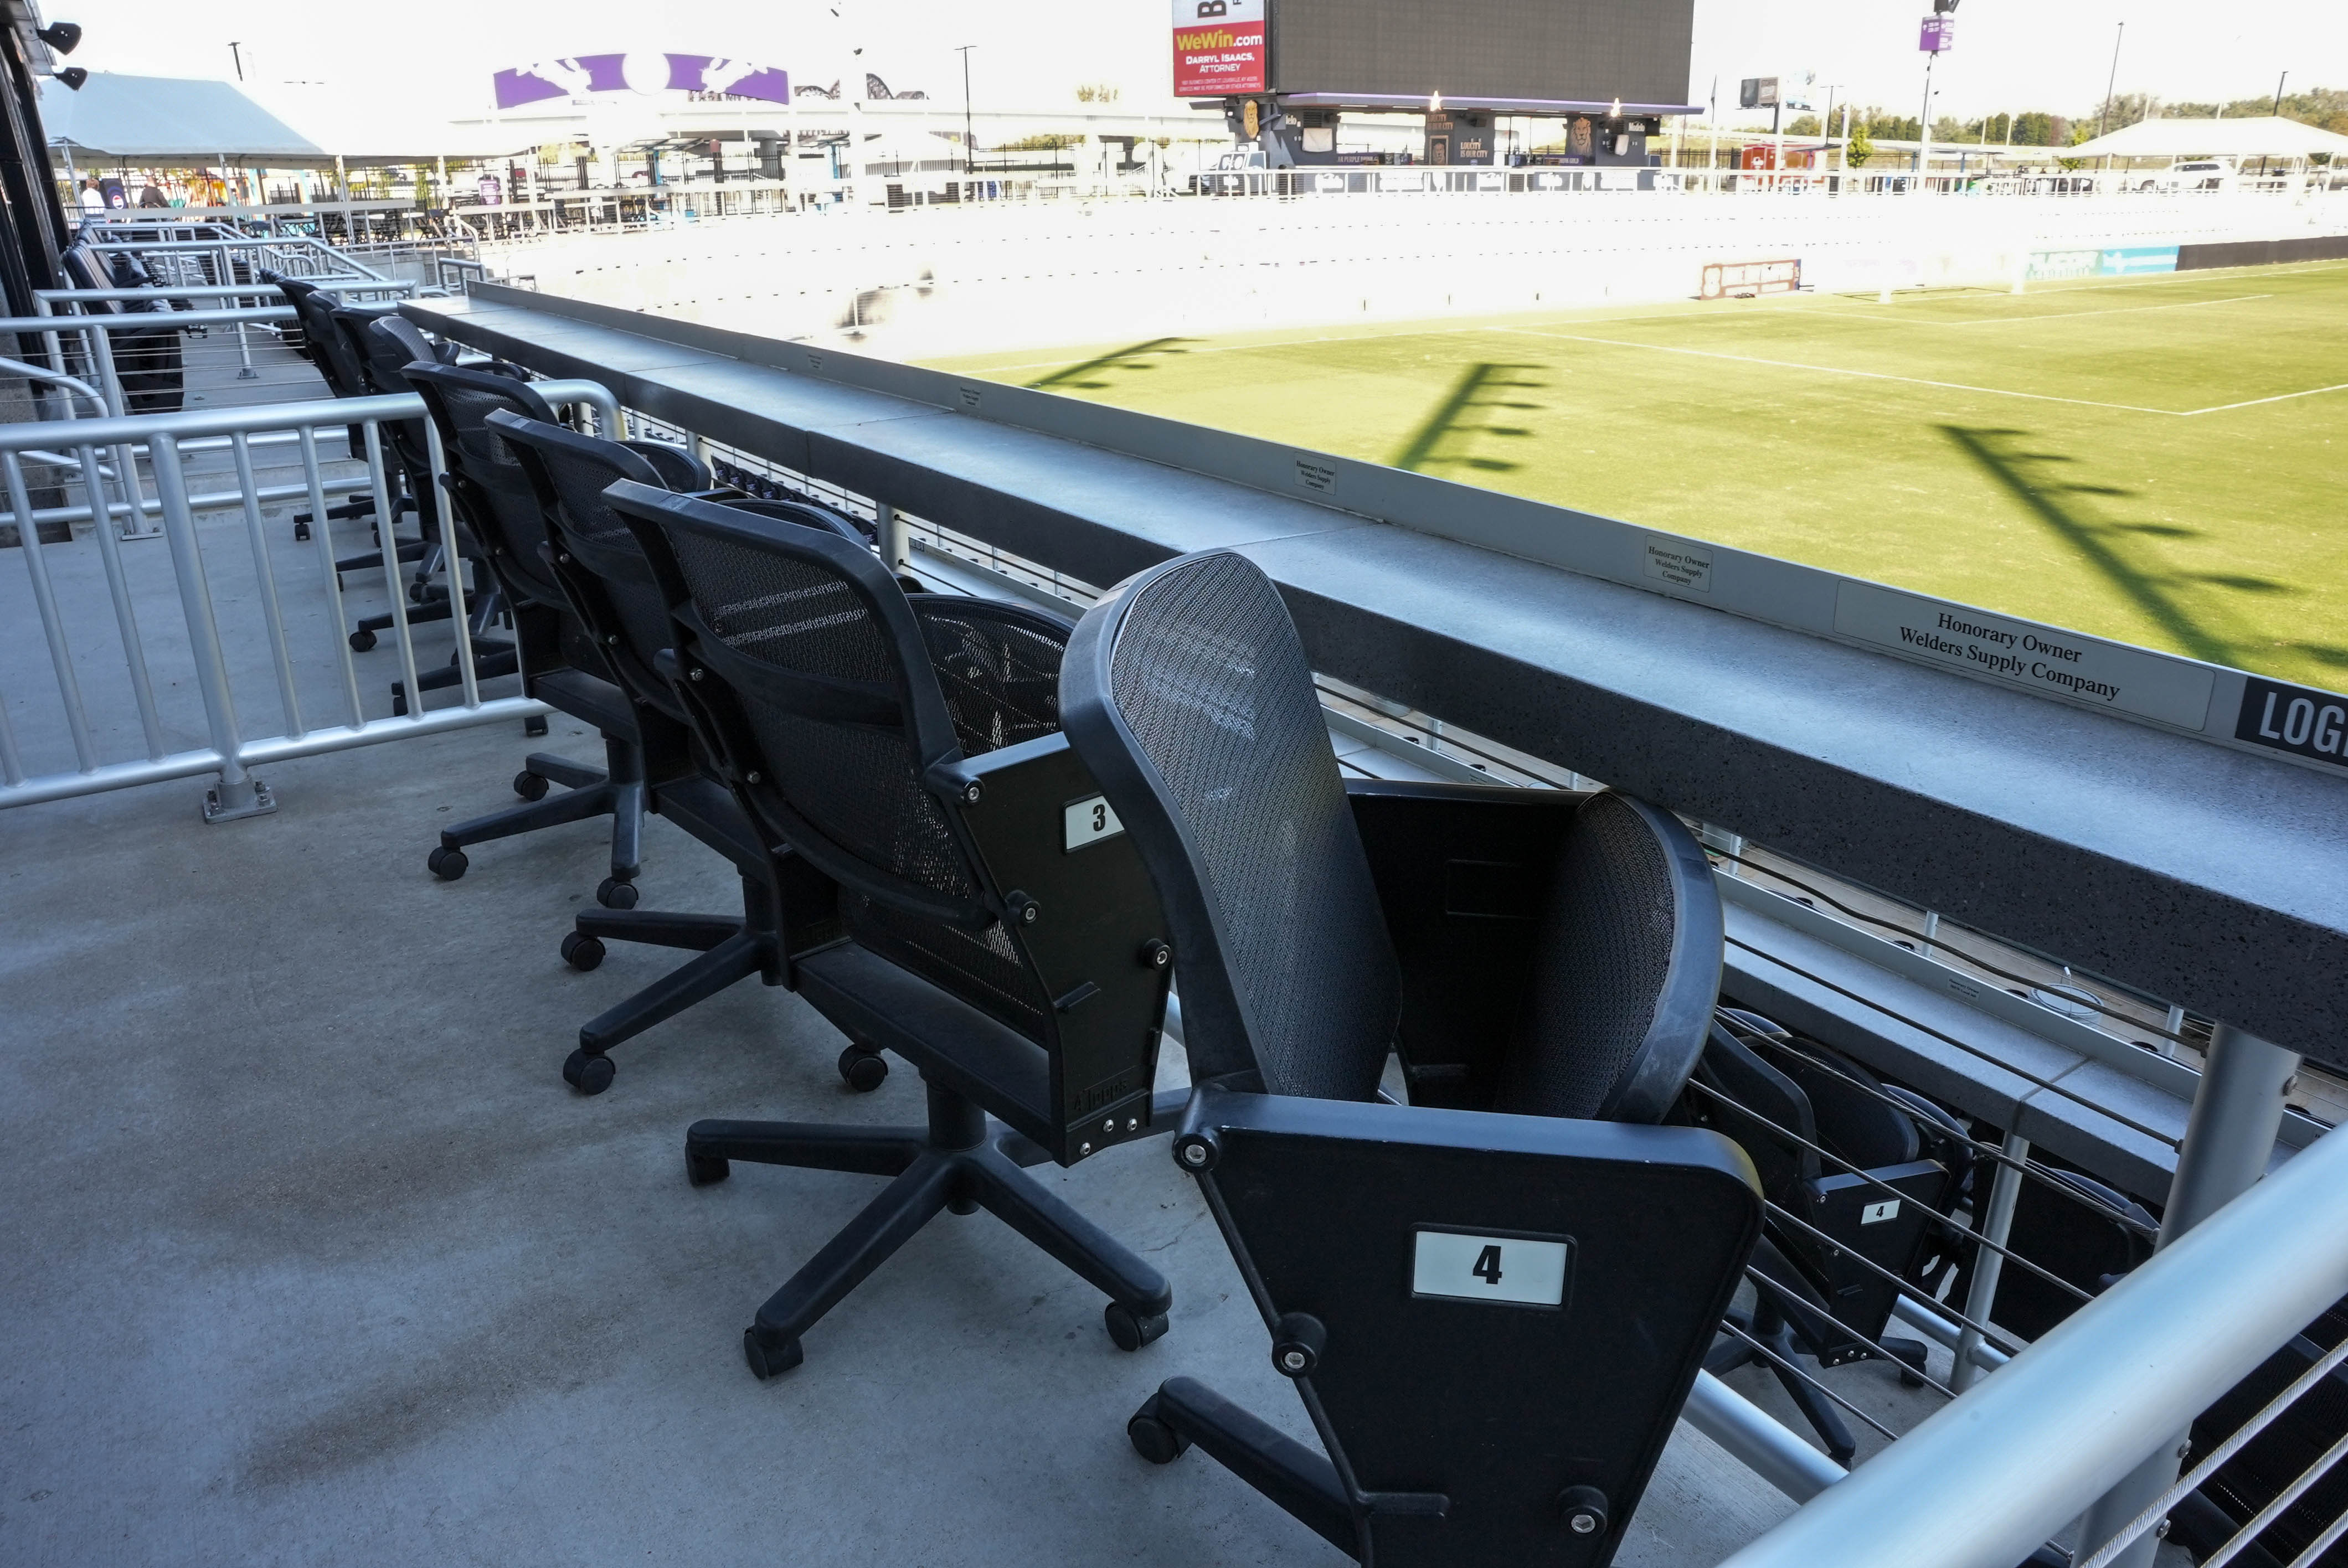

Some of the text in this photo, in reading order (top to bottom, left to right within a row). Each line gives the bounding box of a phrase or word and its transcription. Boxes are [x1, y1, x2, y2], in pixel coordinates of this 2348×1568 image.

[1177, 29, 1263, 51] WeWin.com
[1186, 55, 1219, 65] DARRYL
[1199, 64, 1240, 73] ATTORNEY
[1649, 546, 1709, 569] Honorary Owner
[1655, 559, 1702, 578] Welders Supply
[1662, 570, 1691, 585] Company
[1938, 612, 2082, 663] Honorary Owner
[1900, 626, 2121, 702] Welders Supply Company
[2259, 692, 2348, 757] LOG
[1093, 804, 1106, 832] 3
[1876, 1205, 1884, 1218] 4
[1472, 1245, 1502, 1285] 4
